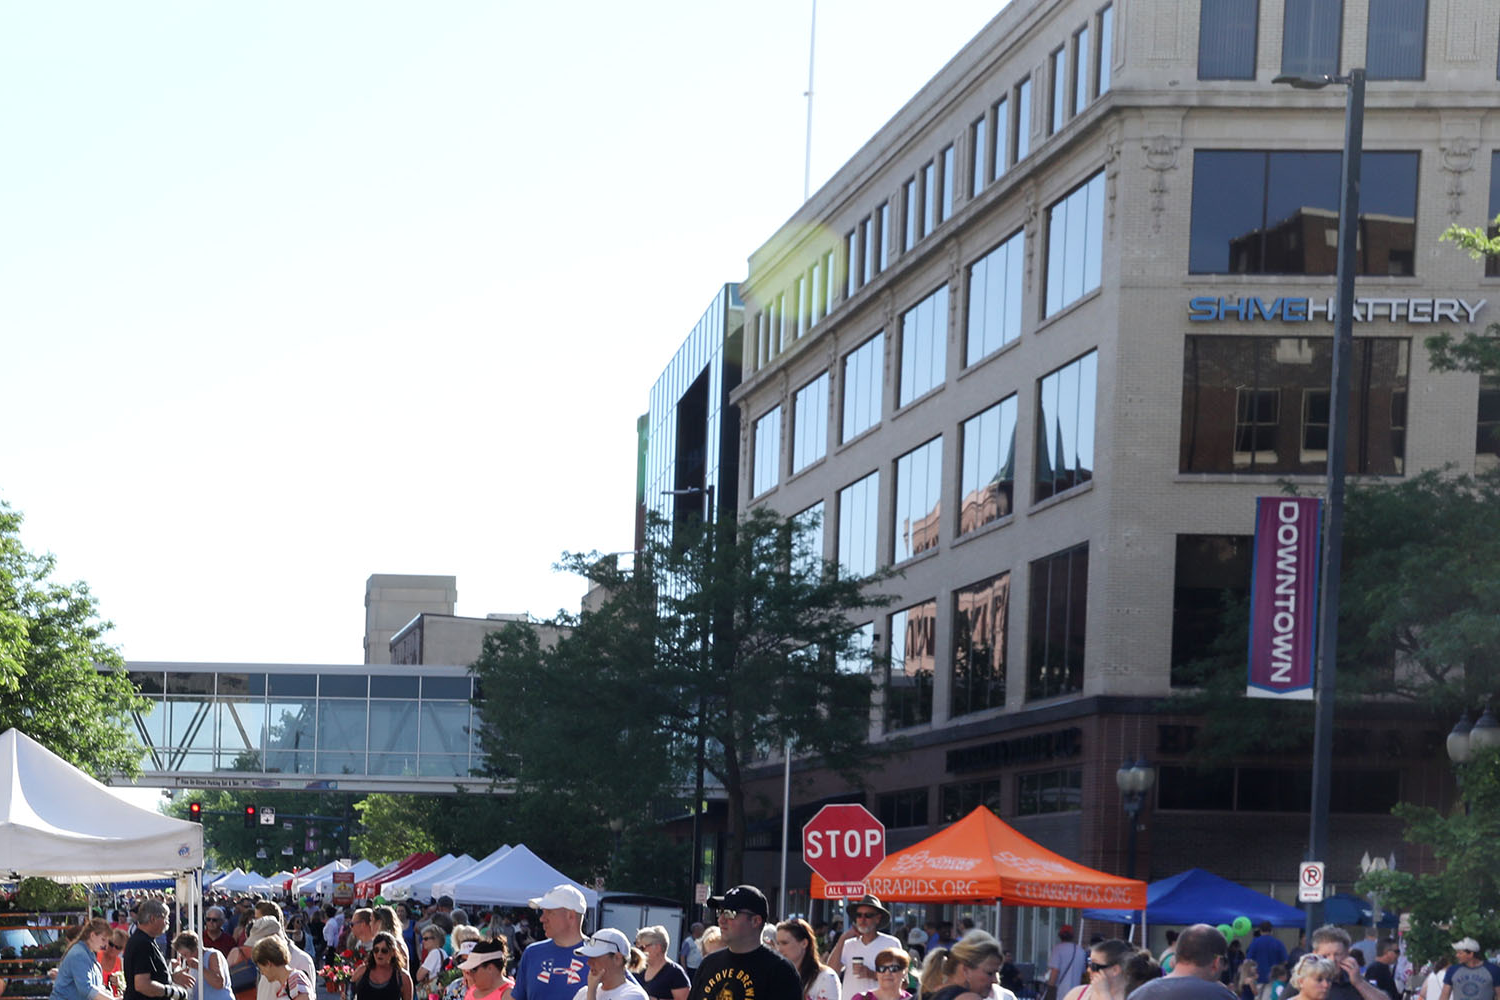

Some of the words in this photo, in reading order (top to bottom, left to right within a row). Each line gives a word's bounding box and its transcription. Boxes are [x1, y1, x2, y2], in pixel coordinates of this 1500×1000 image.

[1270, 501, 1299, 683] DOWNTOWN
[807, 829, 882, 858] STOP
[828, 887, 842, 895] ALL
[845, 886, 862, 895] WAY
[864, 878, 978, 895] ARRAPIDS.ORG
[1015, 881, 1132, 904] CEDARRAPIDS.ORG
[704, 968, 734, 993] GROVE
